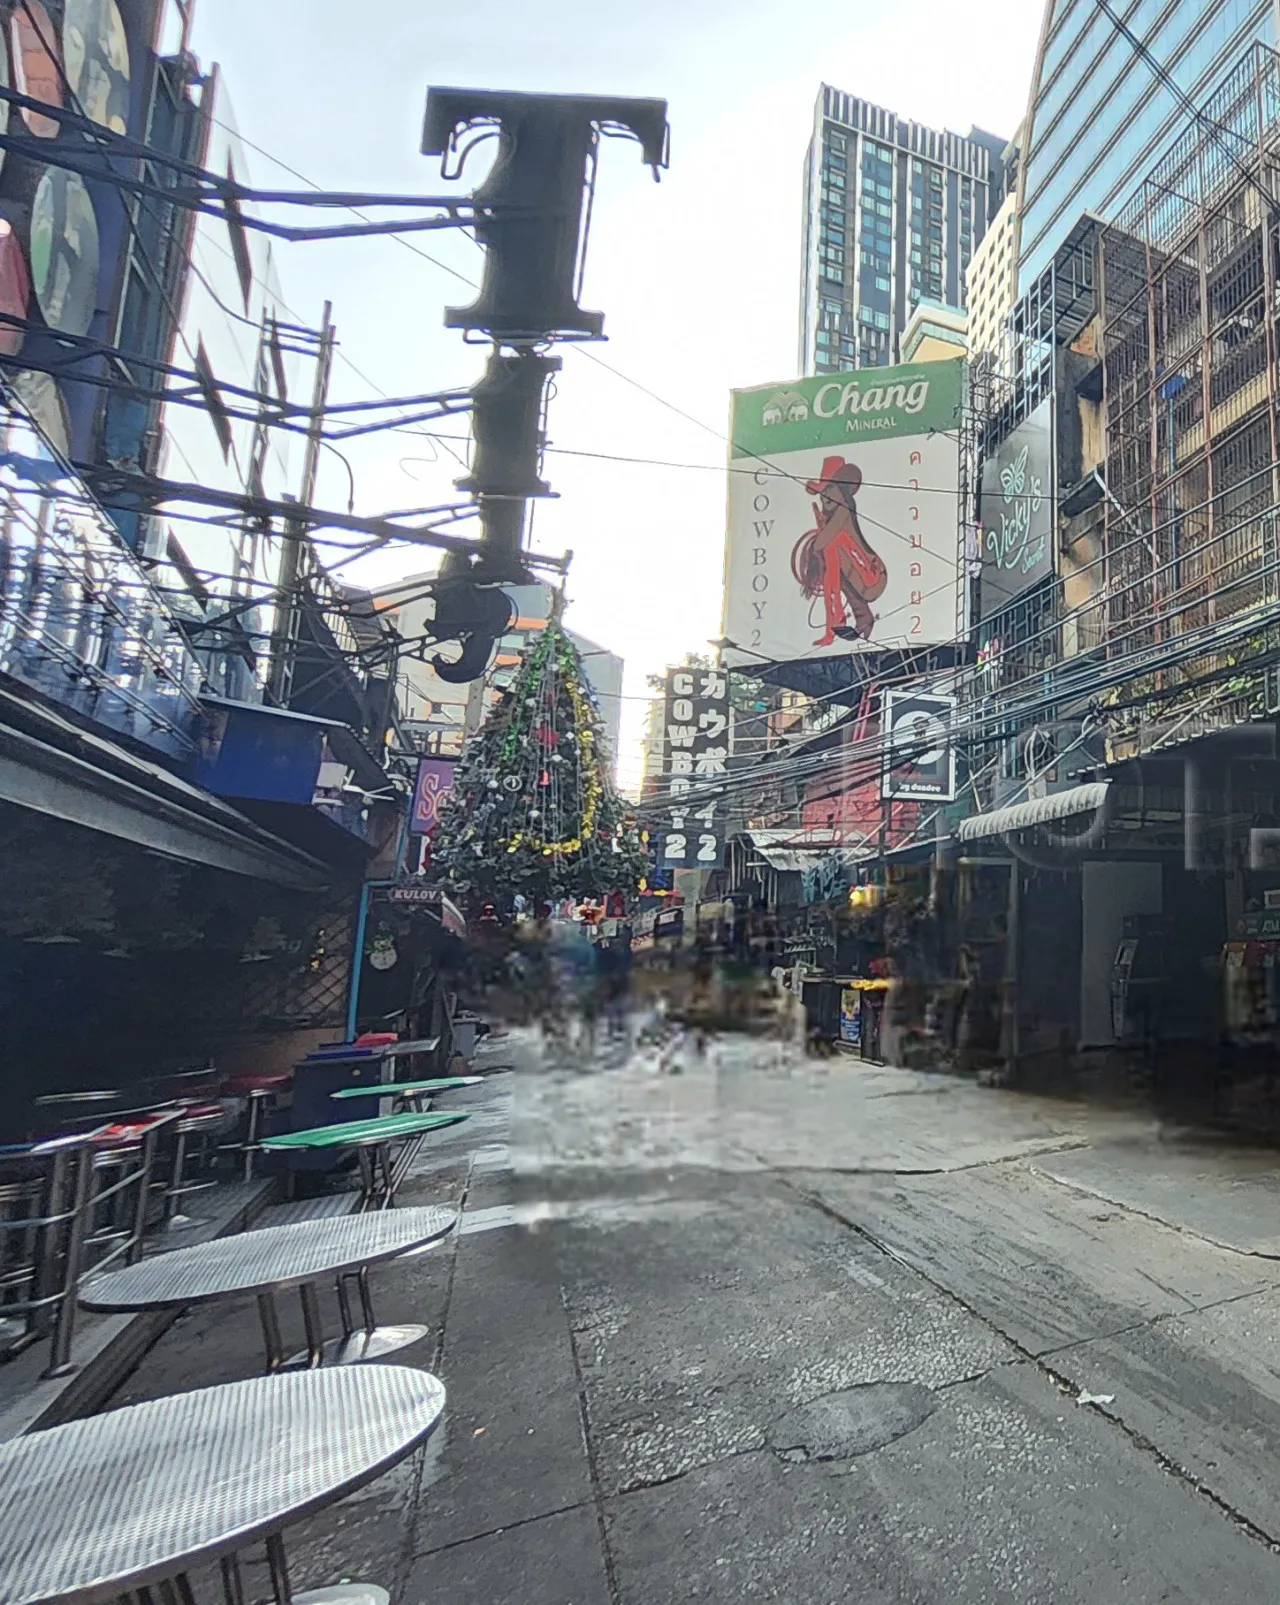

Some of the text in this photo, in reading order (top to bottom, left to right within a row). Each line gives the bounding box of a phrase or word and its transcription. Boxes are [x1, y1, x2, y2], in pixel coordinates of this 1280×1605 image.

[812, 380, 930, 419] Chang
[394, 888, 437, 900] KULOV
[1261, 919, 1280, 933] ATM
